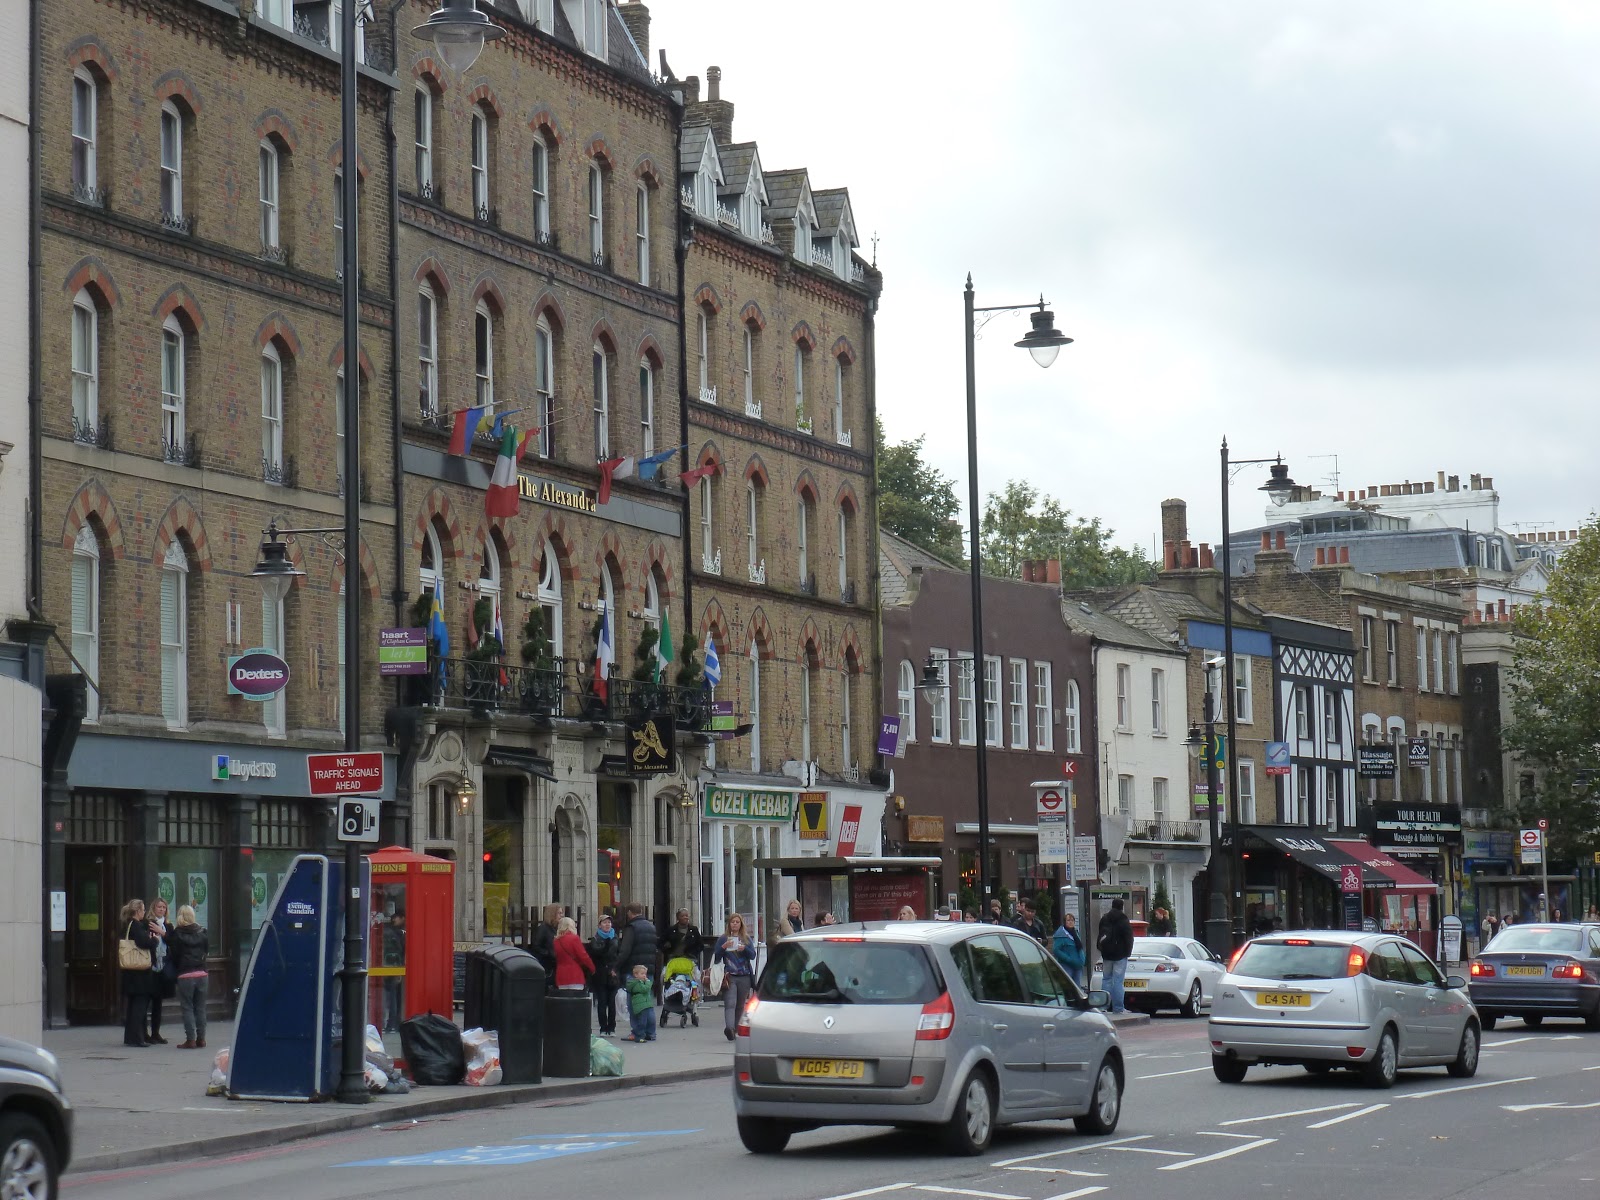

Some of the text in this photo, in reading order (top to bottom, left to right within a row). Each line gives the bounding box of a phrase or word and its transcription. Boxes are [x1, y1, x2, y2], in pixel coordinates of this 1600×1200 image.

[517, 474, 597, 512] The Alexandra
[381, 631, 409, 639] haart
[236, 668, 284, 680] Dexters
[1362, 751, 1393, 759] Massage
[336, 758, 355, 767] NEW
[1065, 761, 1075, 773] K
[314, 768, 380, 779] TRAFFIC SIGNALS
[336, 781, 361, 790] AHEAD
[802, 793, 824, 801] KEBABS
[712, 791, 789, 817] GIZEL KEBAB
[1397, 810, 1441, 821] YOUR HEALTH
[1538, 819, 1546, 828] G
[801, 831, 826, 839] BURGERS
[1394, 833, 1413, 844] Massage
[1436, 834, 1445, 842] Tea
[372, 864, 402, 872] PHONE
[1264, 994, 1303, 1005] C4 SAT
[798, 1061, 859, 1075] WG05 VPD
